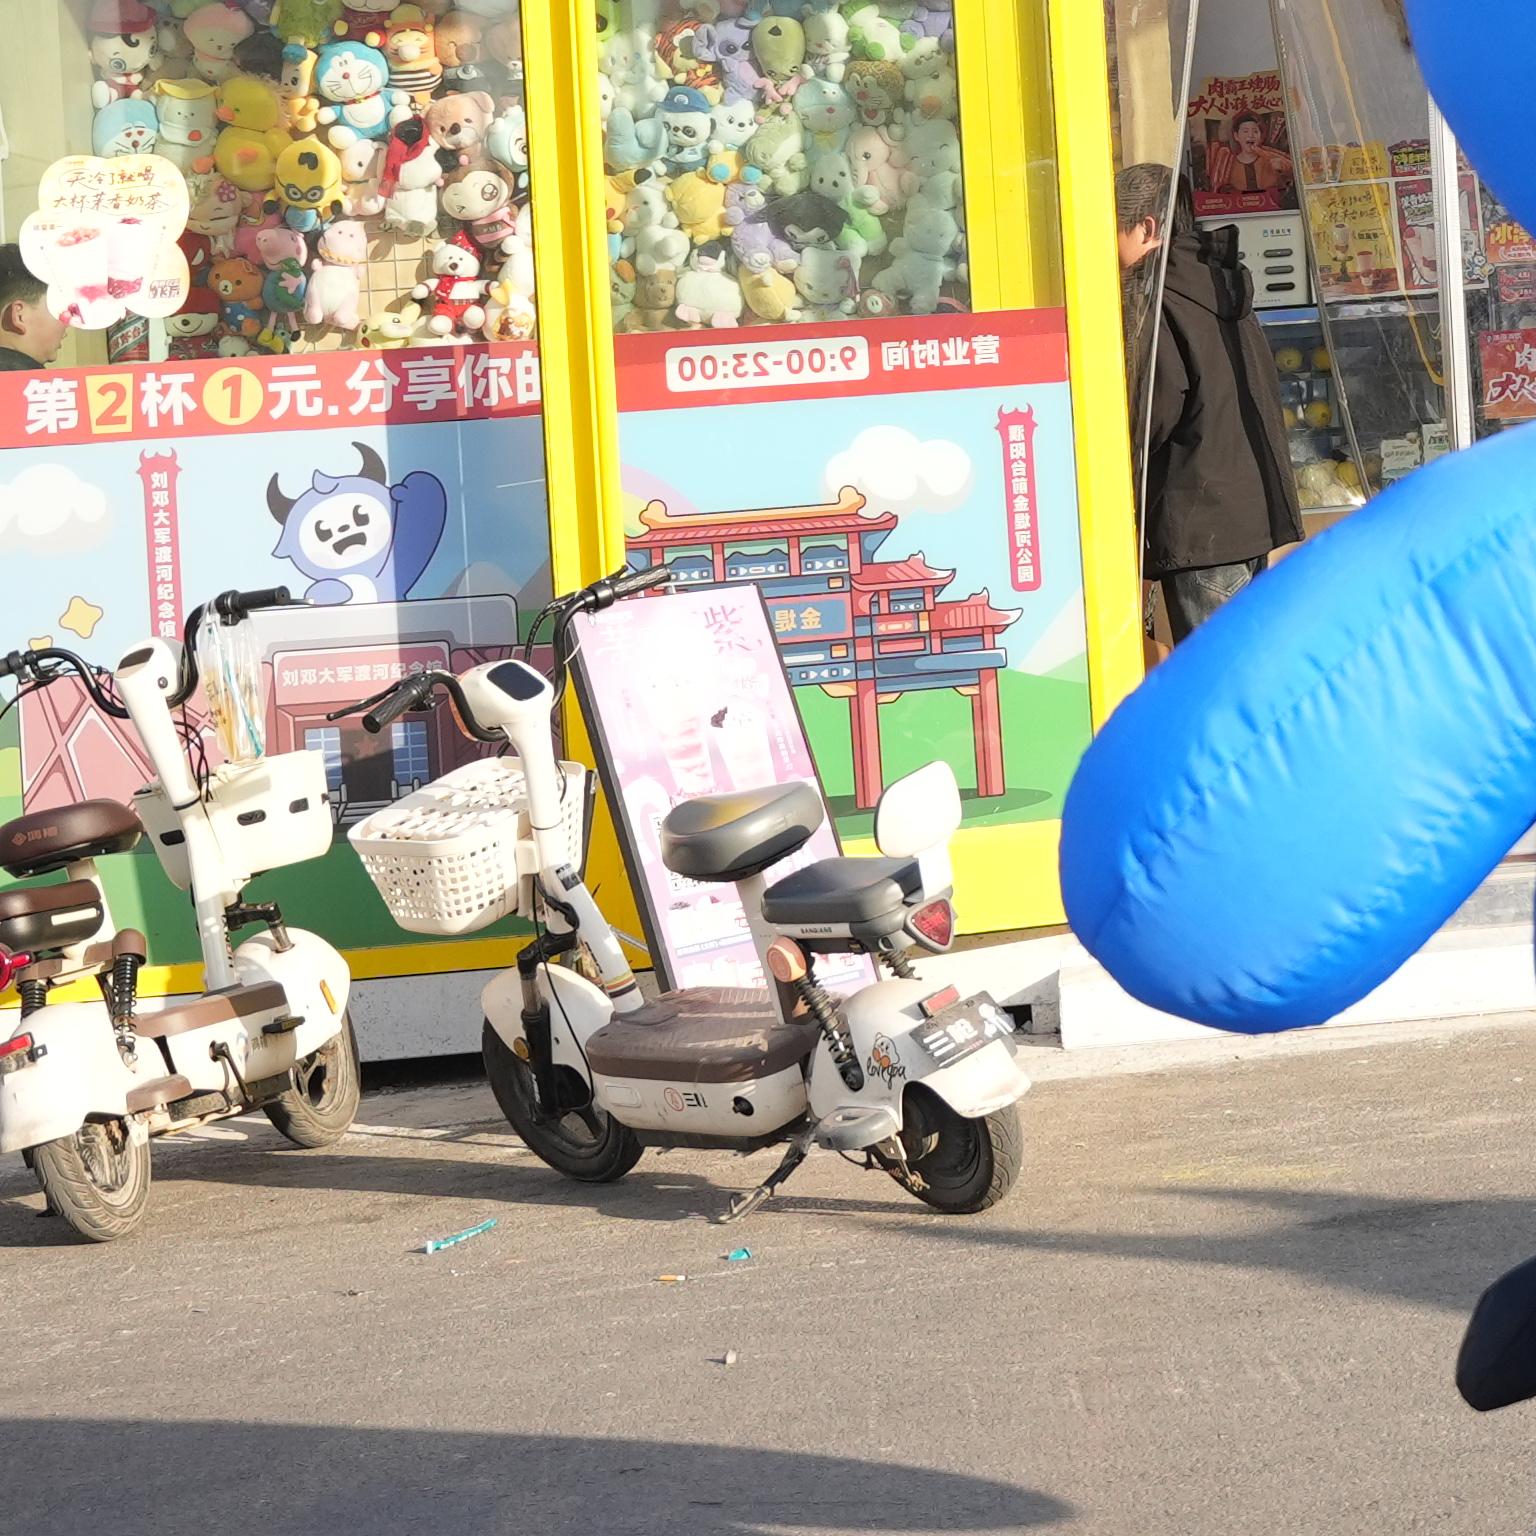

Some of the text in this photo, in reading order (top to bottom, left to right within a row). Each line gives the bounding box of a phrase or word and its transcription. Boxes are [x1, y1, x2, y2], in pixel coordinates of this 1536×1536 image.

[1188, 95, 1284, 117] 大人小孩放心
[149, 471, 177, 639] 刘邓大军渡河纪念馆
